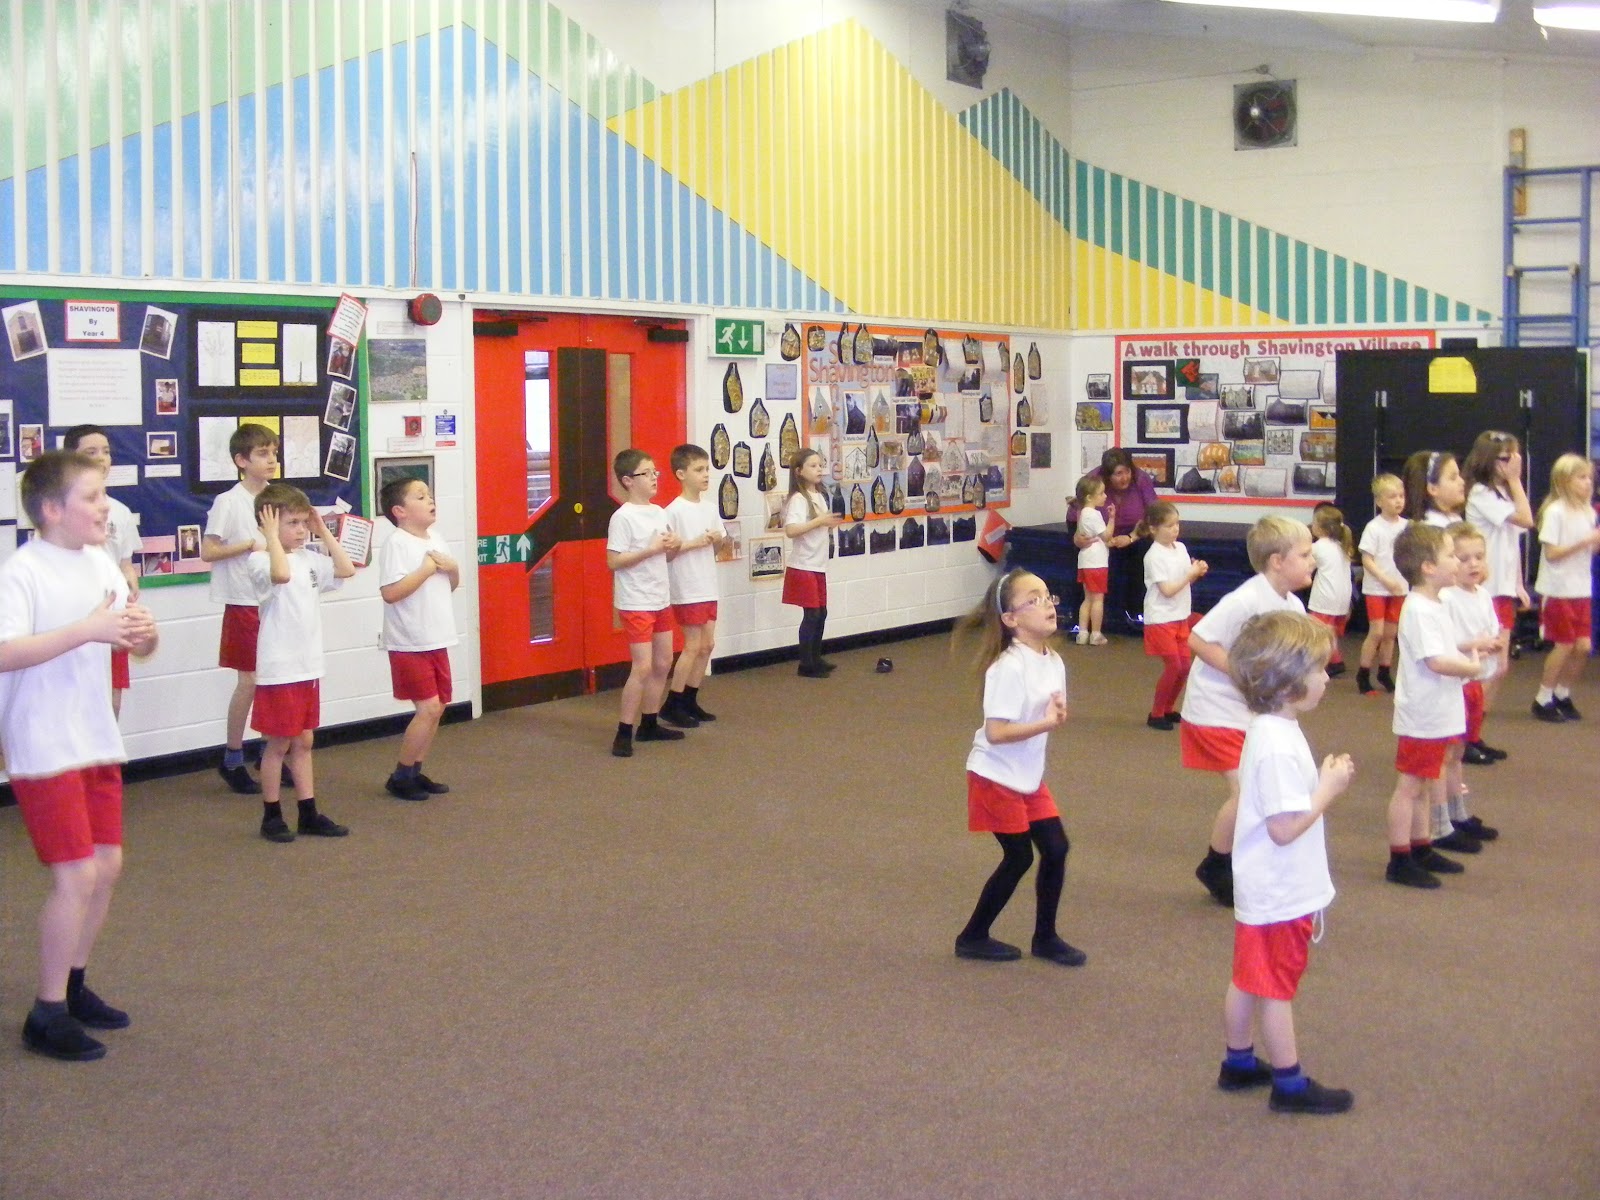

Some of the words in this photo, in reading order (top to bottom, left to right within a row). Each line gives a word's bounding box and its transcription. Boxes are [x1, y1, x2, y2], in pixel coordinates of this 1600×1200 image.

[1124, 342, 1137, 357] A
[1139, 341, 1179, 357] walk
[1182, 339, 1250, 359] through
[1257, 338, 1355, 357] Shavington
[809, 357, 896, 389] Shavington
[477, 538, 488, 548] RE
